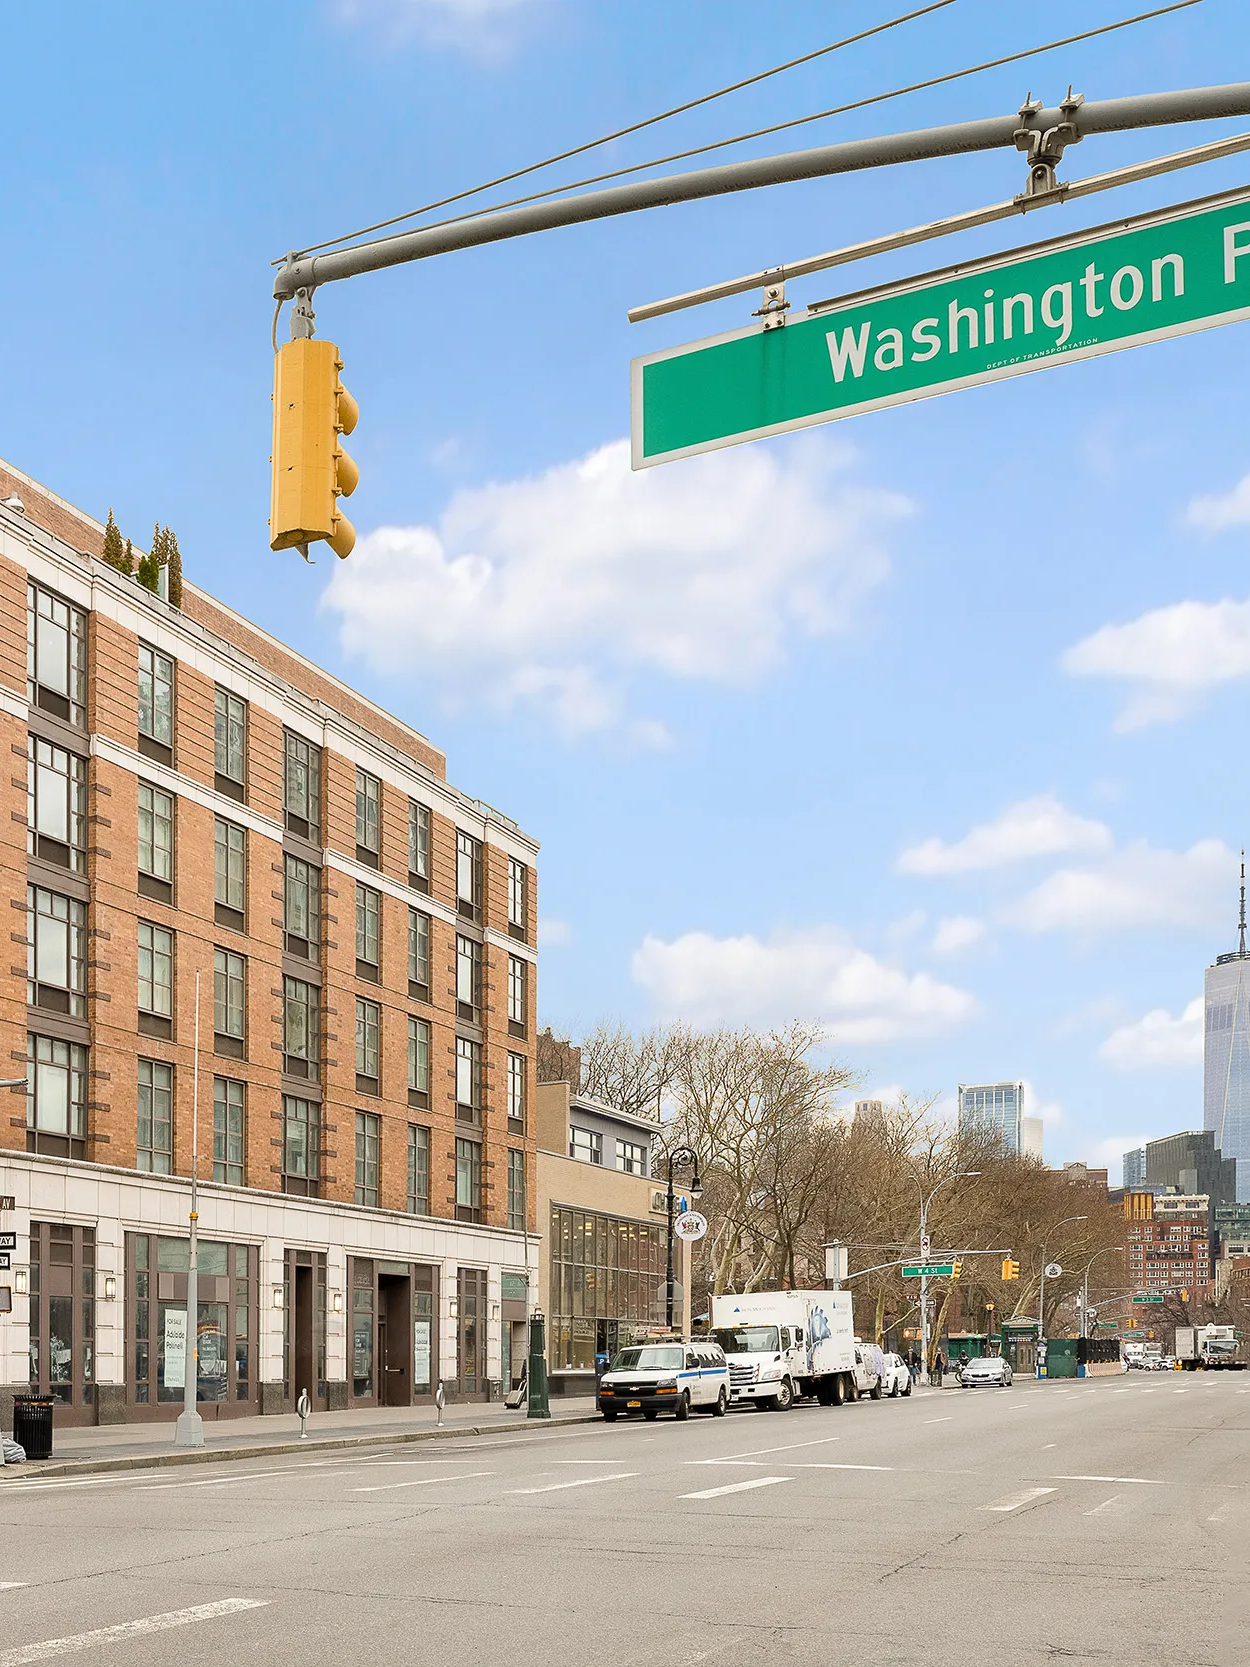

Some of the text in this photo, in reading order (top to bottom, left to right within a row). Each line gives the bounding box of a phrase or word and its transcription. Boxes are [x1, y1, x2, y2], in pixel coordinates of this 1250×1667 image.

[825, 253, 1185, 383] Washington
[986, 337, 1099, 370] DEPT OF TRANSPORTATION
[3, 1198, 11, 1209] AV
